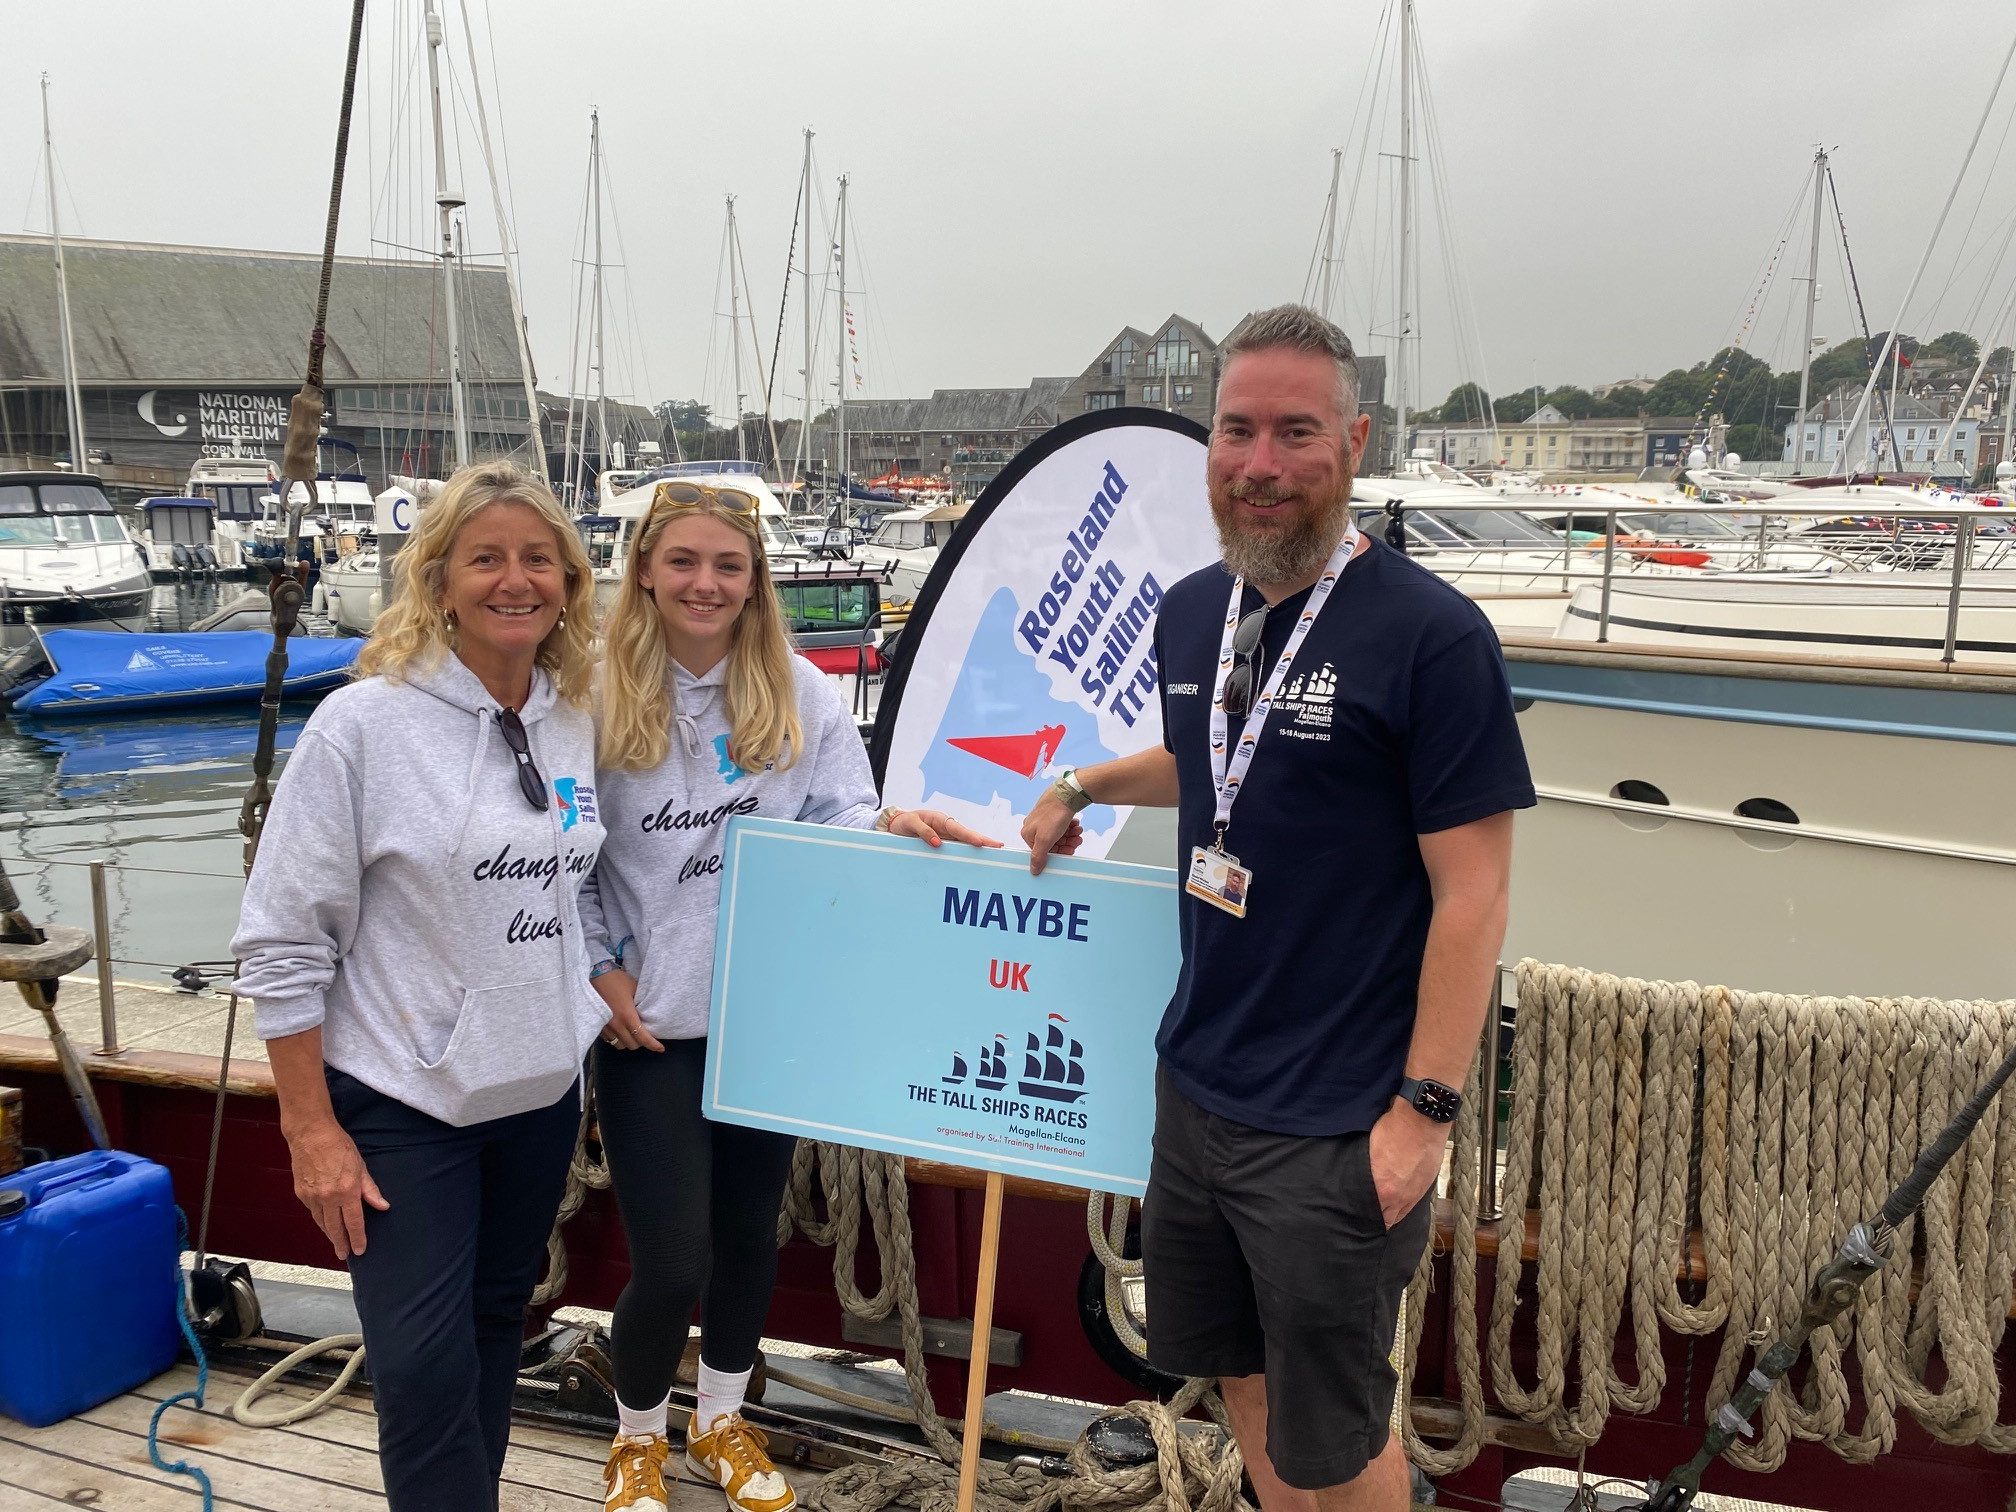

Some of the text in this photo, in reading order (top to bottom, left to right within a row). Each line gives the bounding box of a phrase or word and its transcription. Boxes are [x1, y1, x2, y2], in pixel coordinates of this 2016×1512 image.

[199, 392, 287, 411] NATIONAL
[200, 408, 288, 426] MARITIME
[201, 423, 279, 441] MUSEUM
[393, 498, 411, 531] C
[1018, 459, 1129, 654] Roseland
[1049, 559, 1126, 674] Youth
[1081, 571, 1165, 707] Sailing
[1109, 642, 1158, 728] Tru
[1272, 701, 1333, 715] TALL SHIPS RACES
[1298, 712, 1332, 722] Falmouth
[1293, 730, 1315, 740] August
[1315, 733, 1331, 741] 2023
[942, 886, 1091, 943] MAYBE
[989, 958, 1032, 993] UK
[907, 1084, 1088, 1129] THE TALL SHIPS RACES
[936, 1126, 974, 1137] organised
[976, 1131, 986, 1141] by
[1004, 1136, 1034, 1150] Training
[1036, 1142, 1086, 1157] International
[1008, 1124, 1086, 1146] Magellan-Elcano
